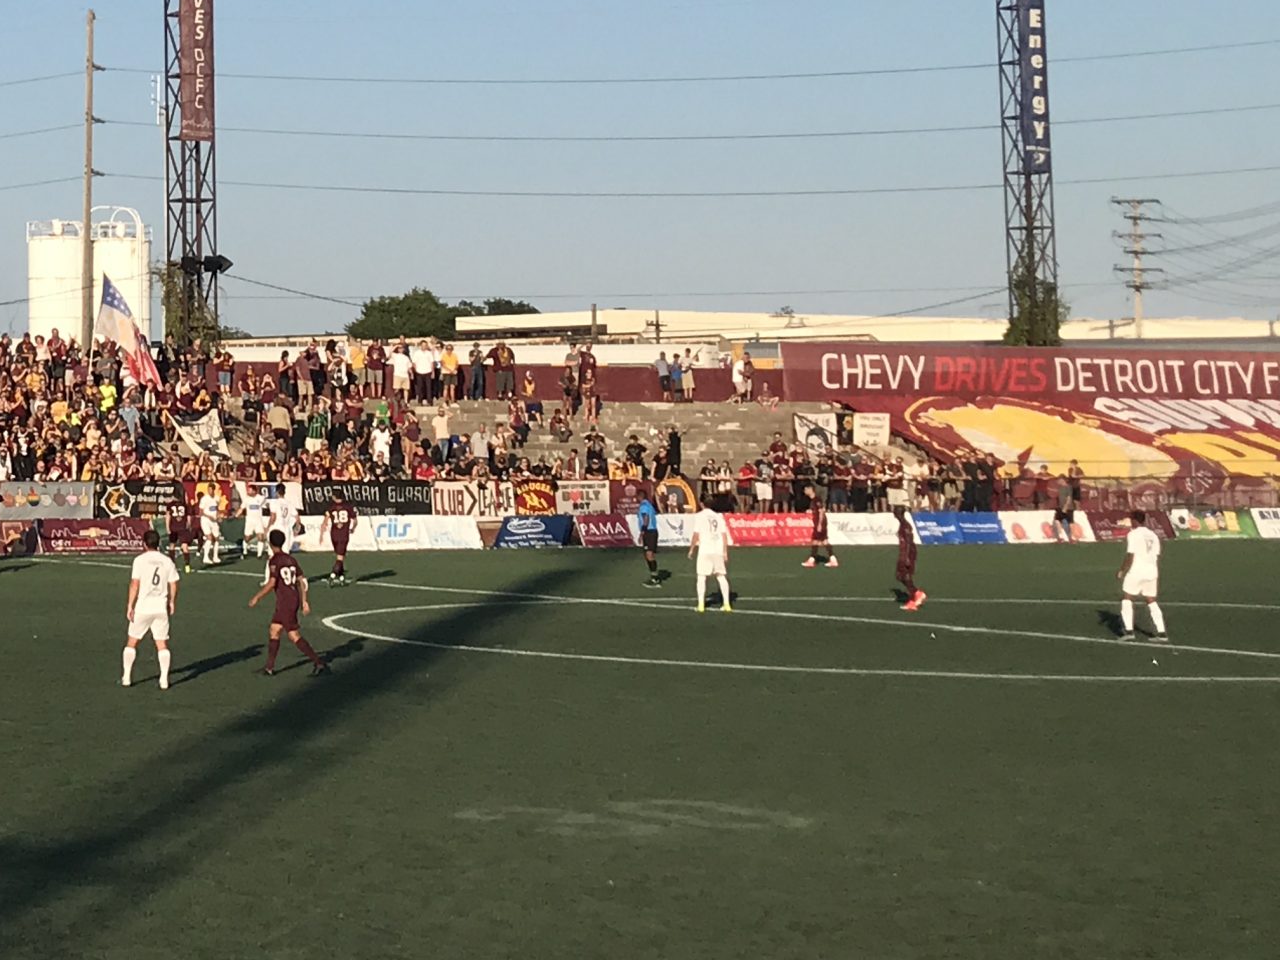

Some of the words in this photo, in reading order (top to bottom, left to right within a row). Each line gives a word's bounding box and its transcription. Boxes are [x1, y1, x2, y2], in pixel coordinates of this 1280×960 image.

[194, 48, 205, 109] DCFC
[1029, 8, 1045, 140] Energy
[821, 353, 925, 390] CHEVY
[933, 356, 1047, 392] DRIVES
[1054, 357, 1185, 394] DETROIT
[1193, 359, 1255, 395] CITY
[171, 505, 185, 517] 13
[433, 488, 467, 516] CLUB
[331, 509, 349, 524] 18
[376, 517, 412, 538] riis
[580, 522, 627, 537] PAMA
[151, 566, 161, 587] 6
